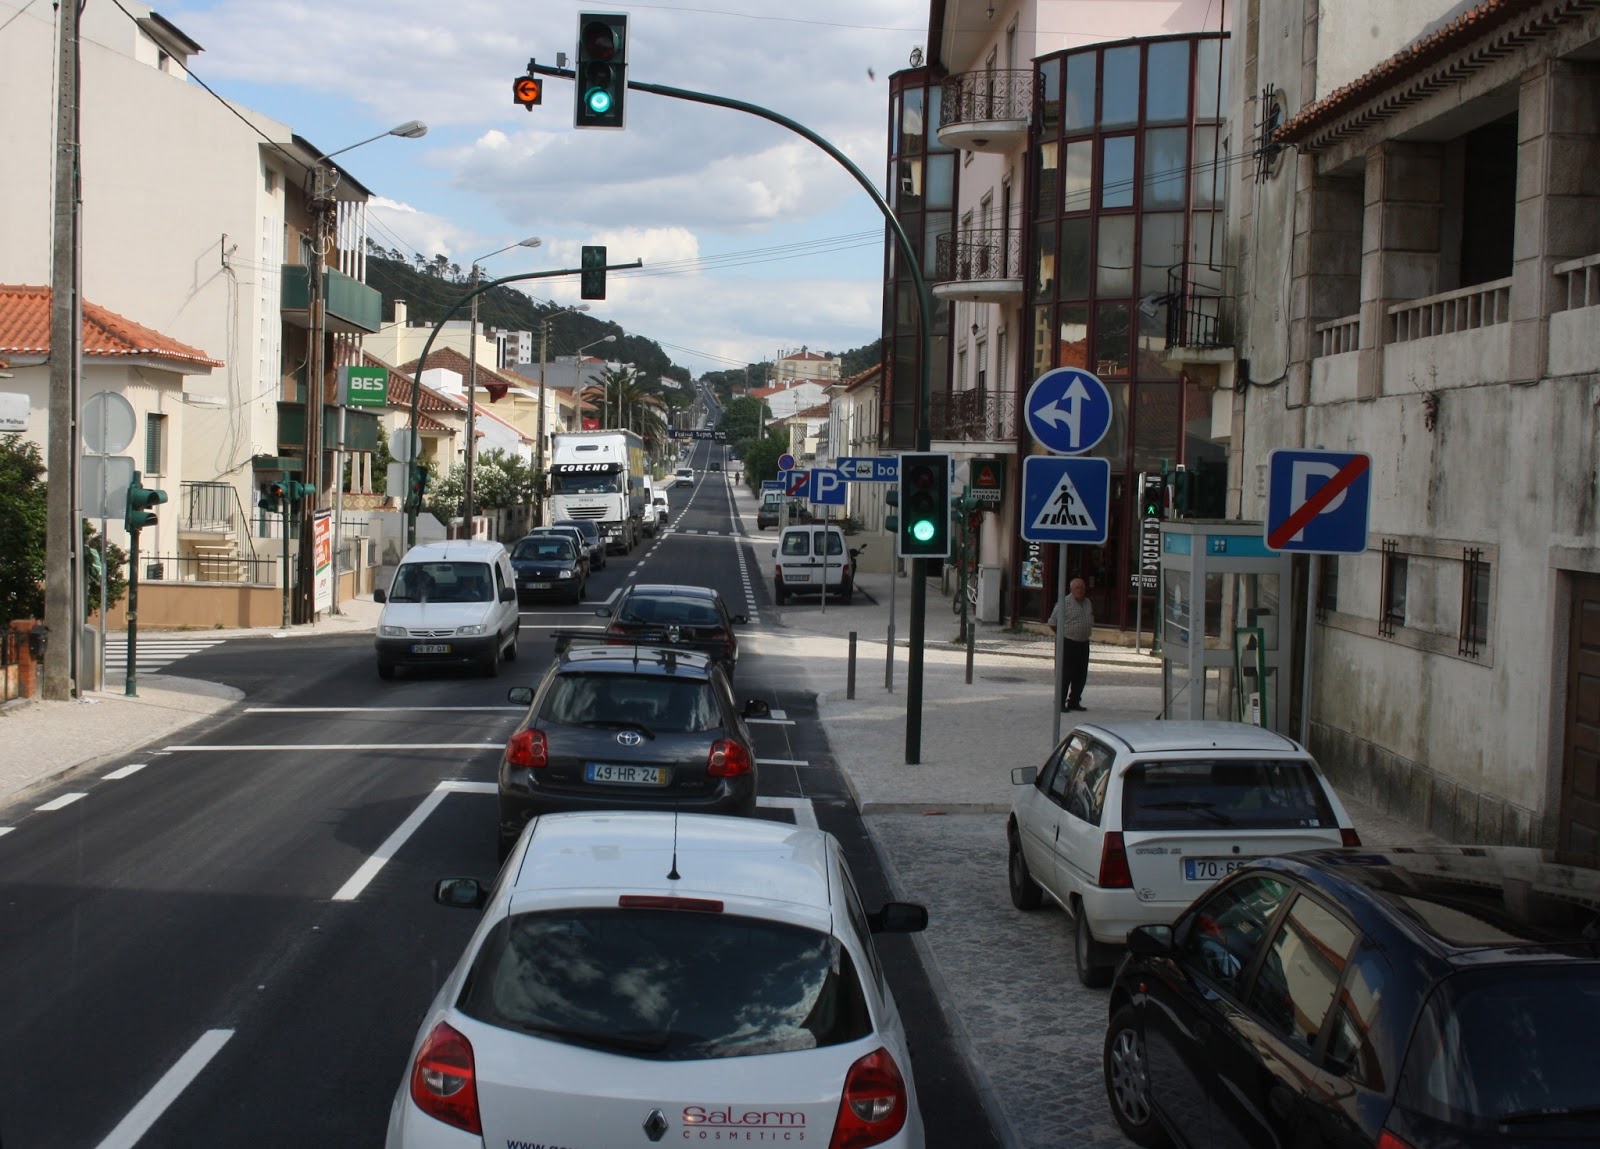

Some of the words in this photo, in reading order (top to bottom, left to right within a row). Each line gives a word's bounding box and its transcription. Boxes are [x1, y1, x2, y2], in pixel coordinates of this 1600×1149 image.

[351, 377, 384, 390] BES
[560, 464, 609, 472] CORCHO
[816, 472, 839, 501] P
[1290, 460, 1348, 542] P
[682, 1130, 805, 1141] COSMETICS
